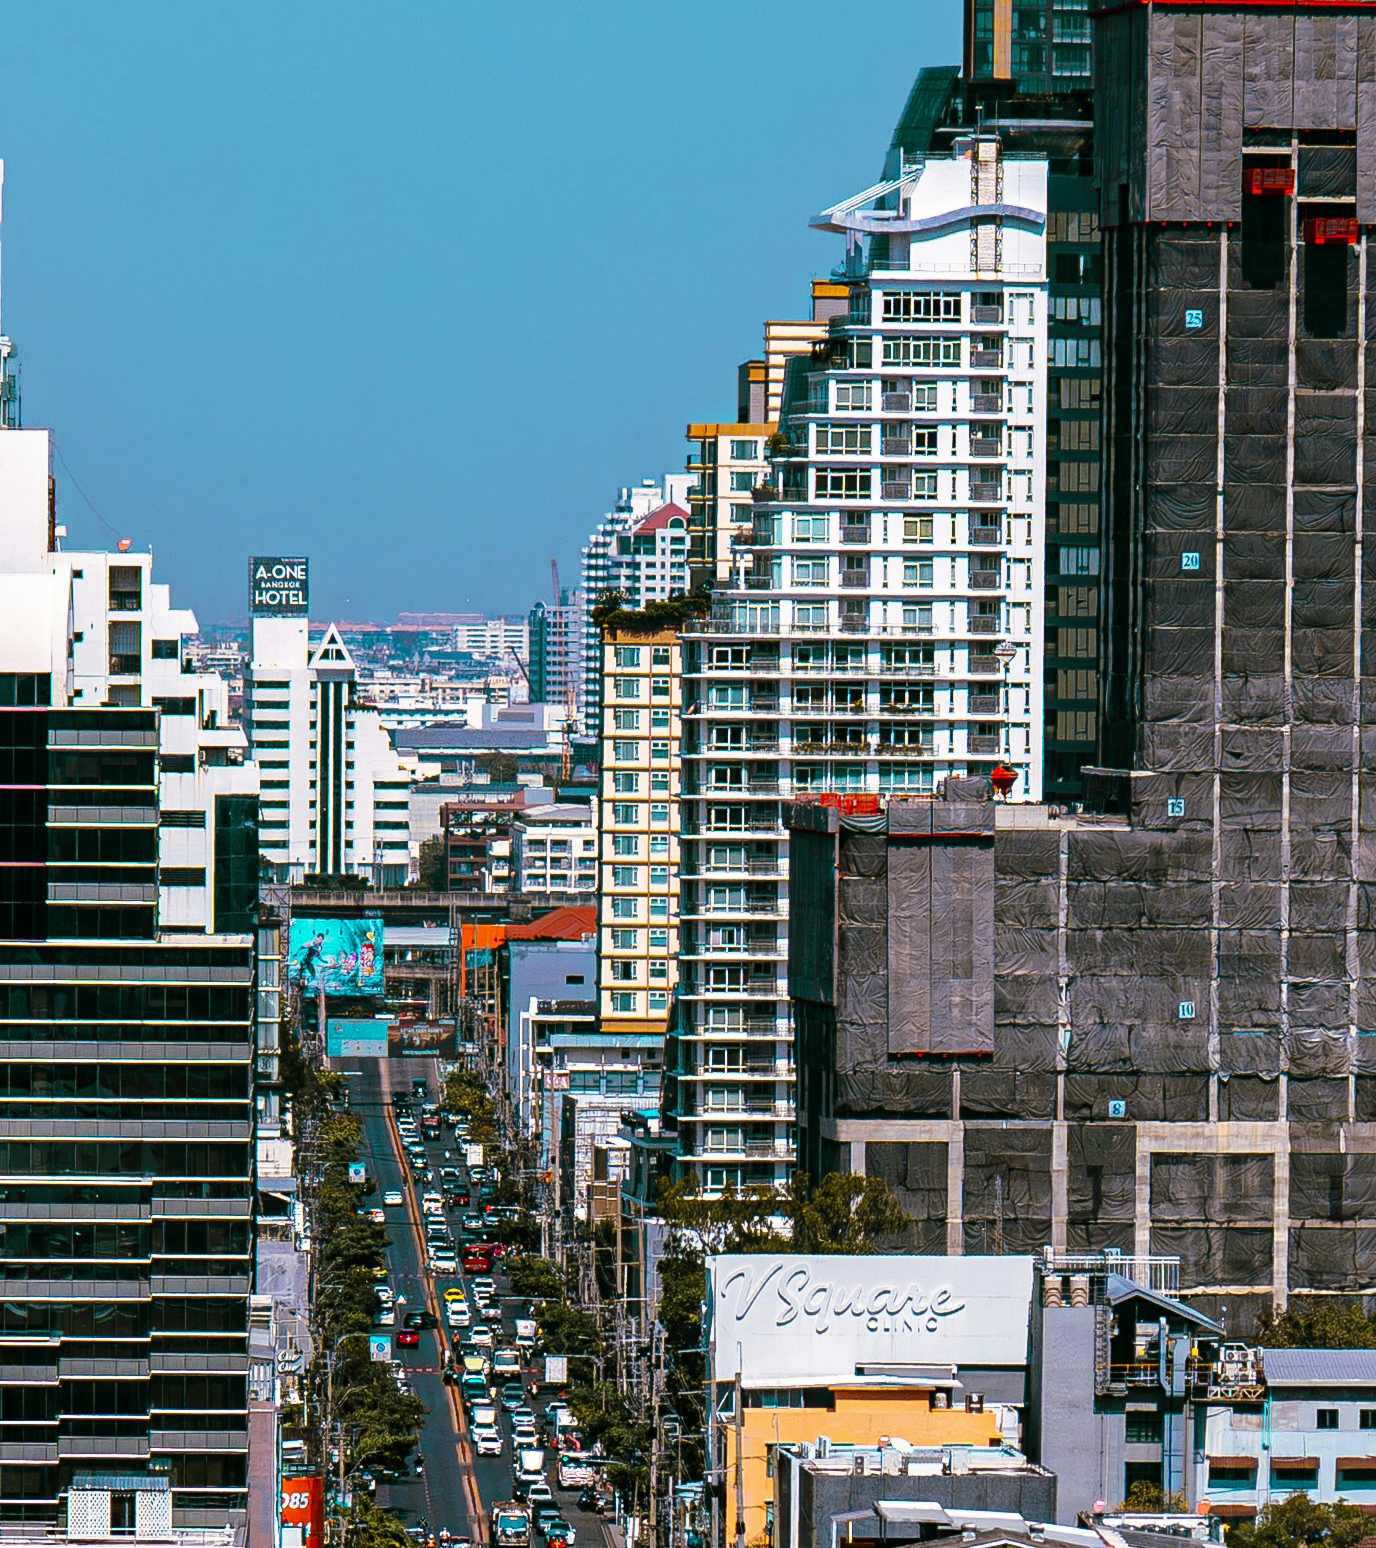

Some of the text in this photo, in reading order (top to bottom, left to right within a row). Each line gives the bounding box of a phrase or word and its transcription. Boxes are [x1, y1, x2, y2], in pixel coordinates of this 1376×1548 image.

[256, 565, 306, 579] A-ONE
[255, 590, 307, 605] HOTEL
[721, 1263, 965, 1334] V Square
[867, 1316, 938, 1333] CLINIC
